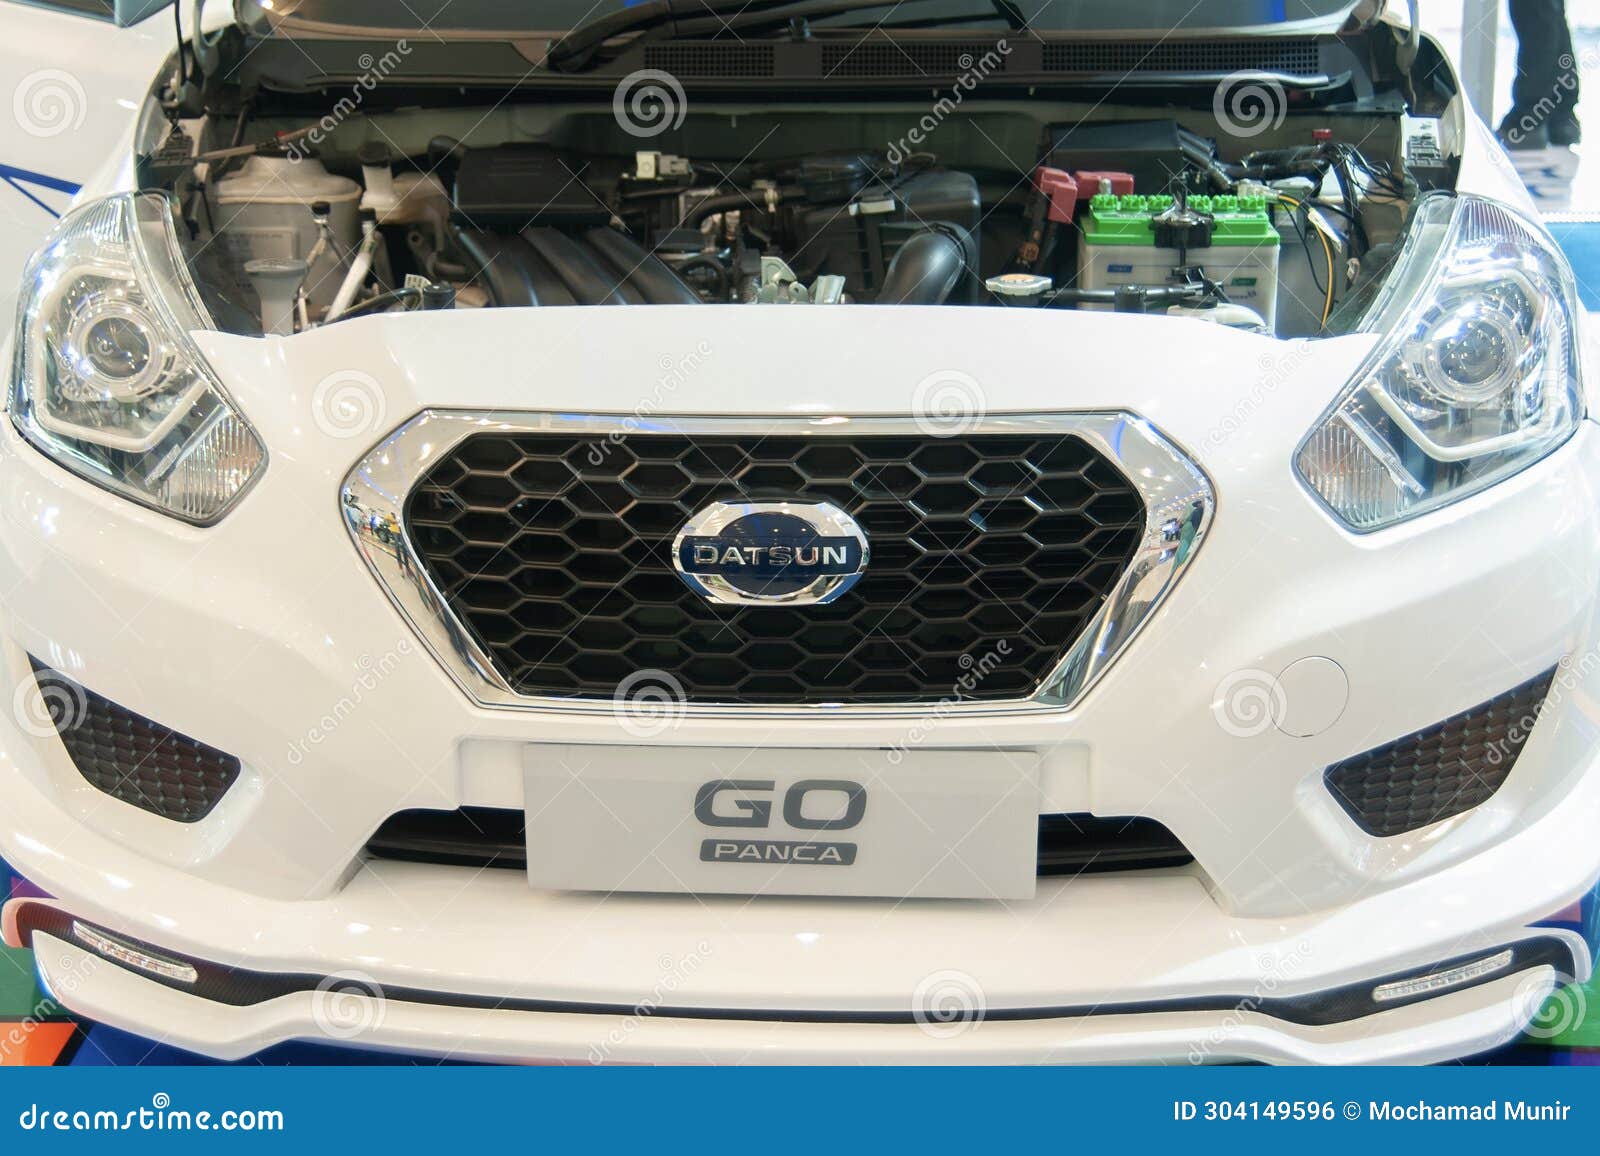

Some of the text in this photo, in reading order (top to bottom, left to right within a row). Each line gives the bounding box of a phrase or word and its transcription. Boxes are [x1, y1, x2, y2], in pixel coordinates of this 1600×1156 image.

[694, 545, 847, 566] DATSUN
[694, 779, 867, 830] GO
[714, 843, 842, 862] PANCA
